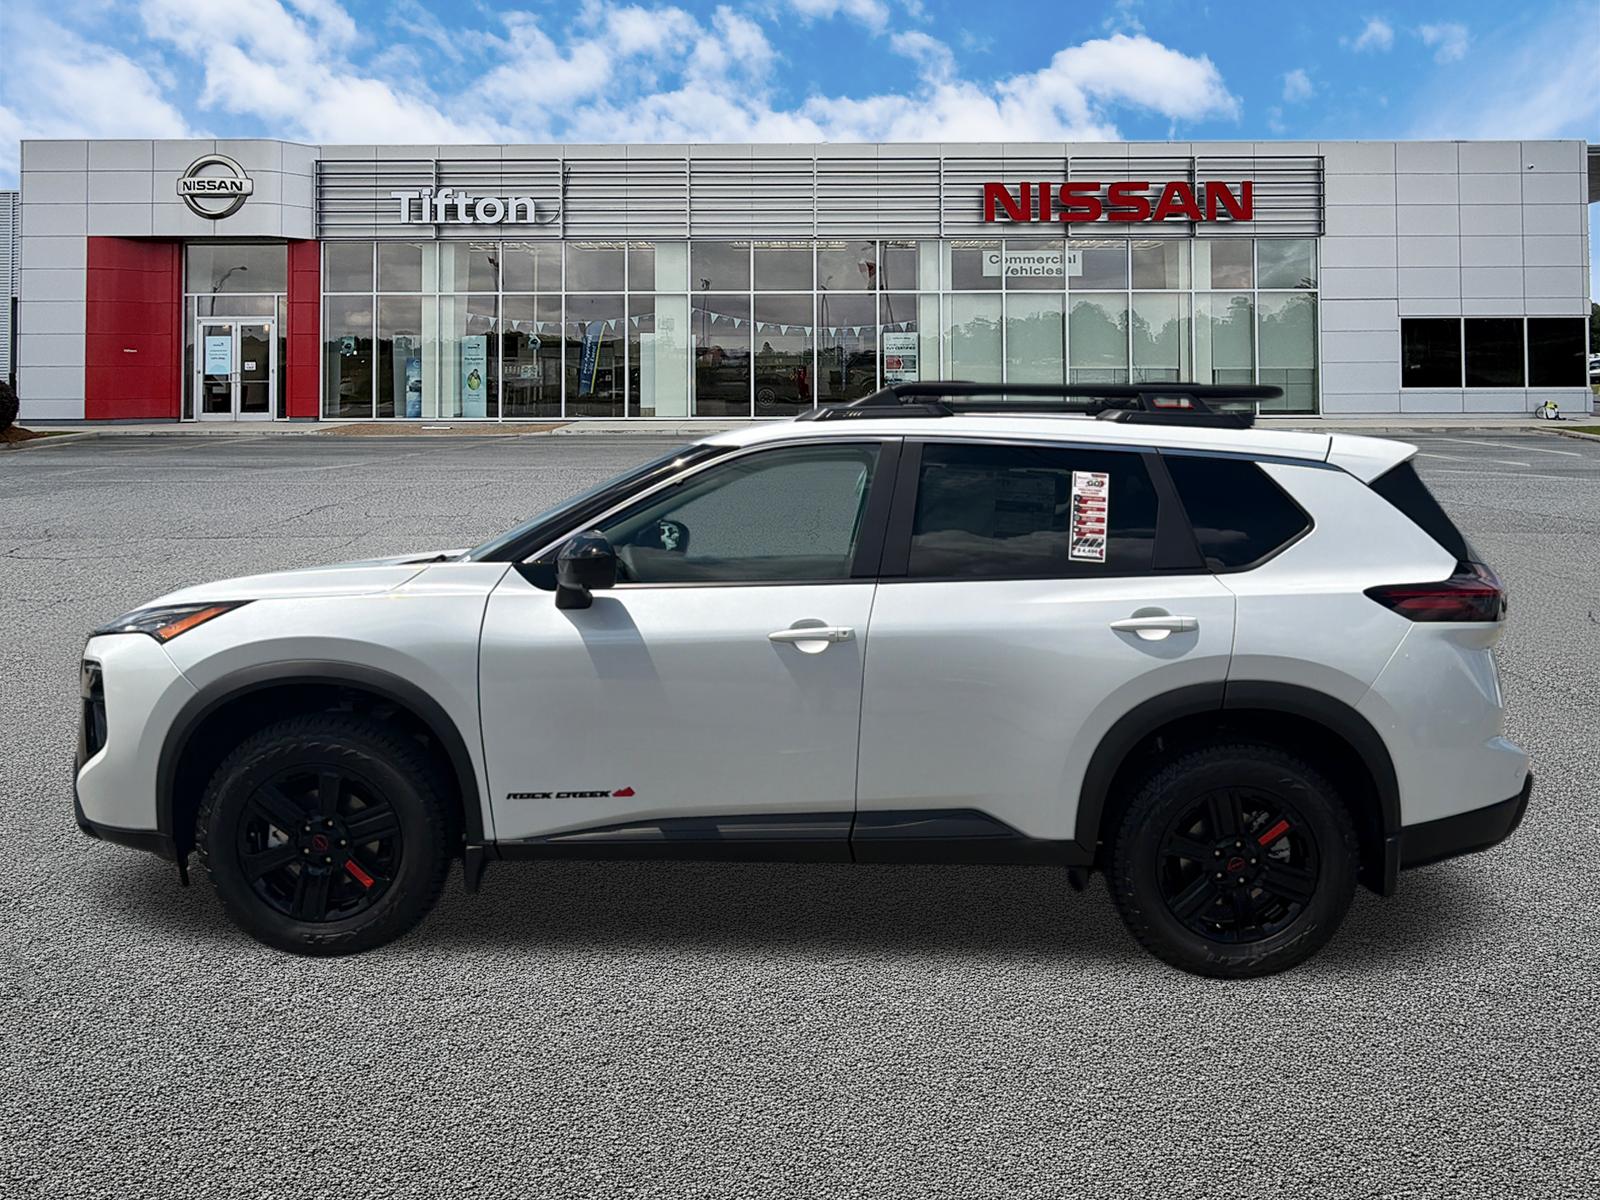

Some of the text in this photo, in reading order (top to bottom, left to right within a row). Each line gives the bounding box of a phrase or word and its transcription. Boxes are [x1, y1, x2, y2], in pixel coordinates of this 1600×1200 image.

[182, 180, 243, 192] NISSAN
[391, 188, 536, 224] Tifton
[984, 181, 1253, 222] NISSAN
[506, 790, 611, 800] ROCK CREEK
